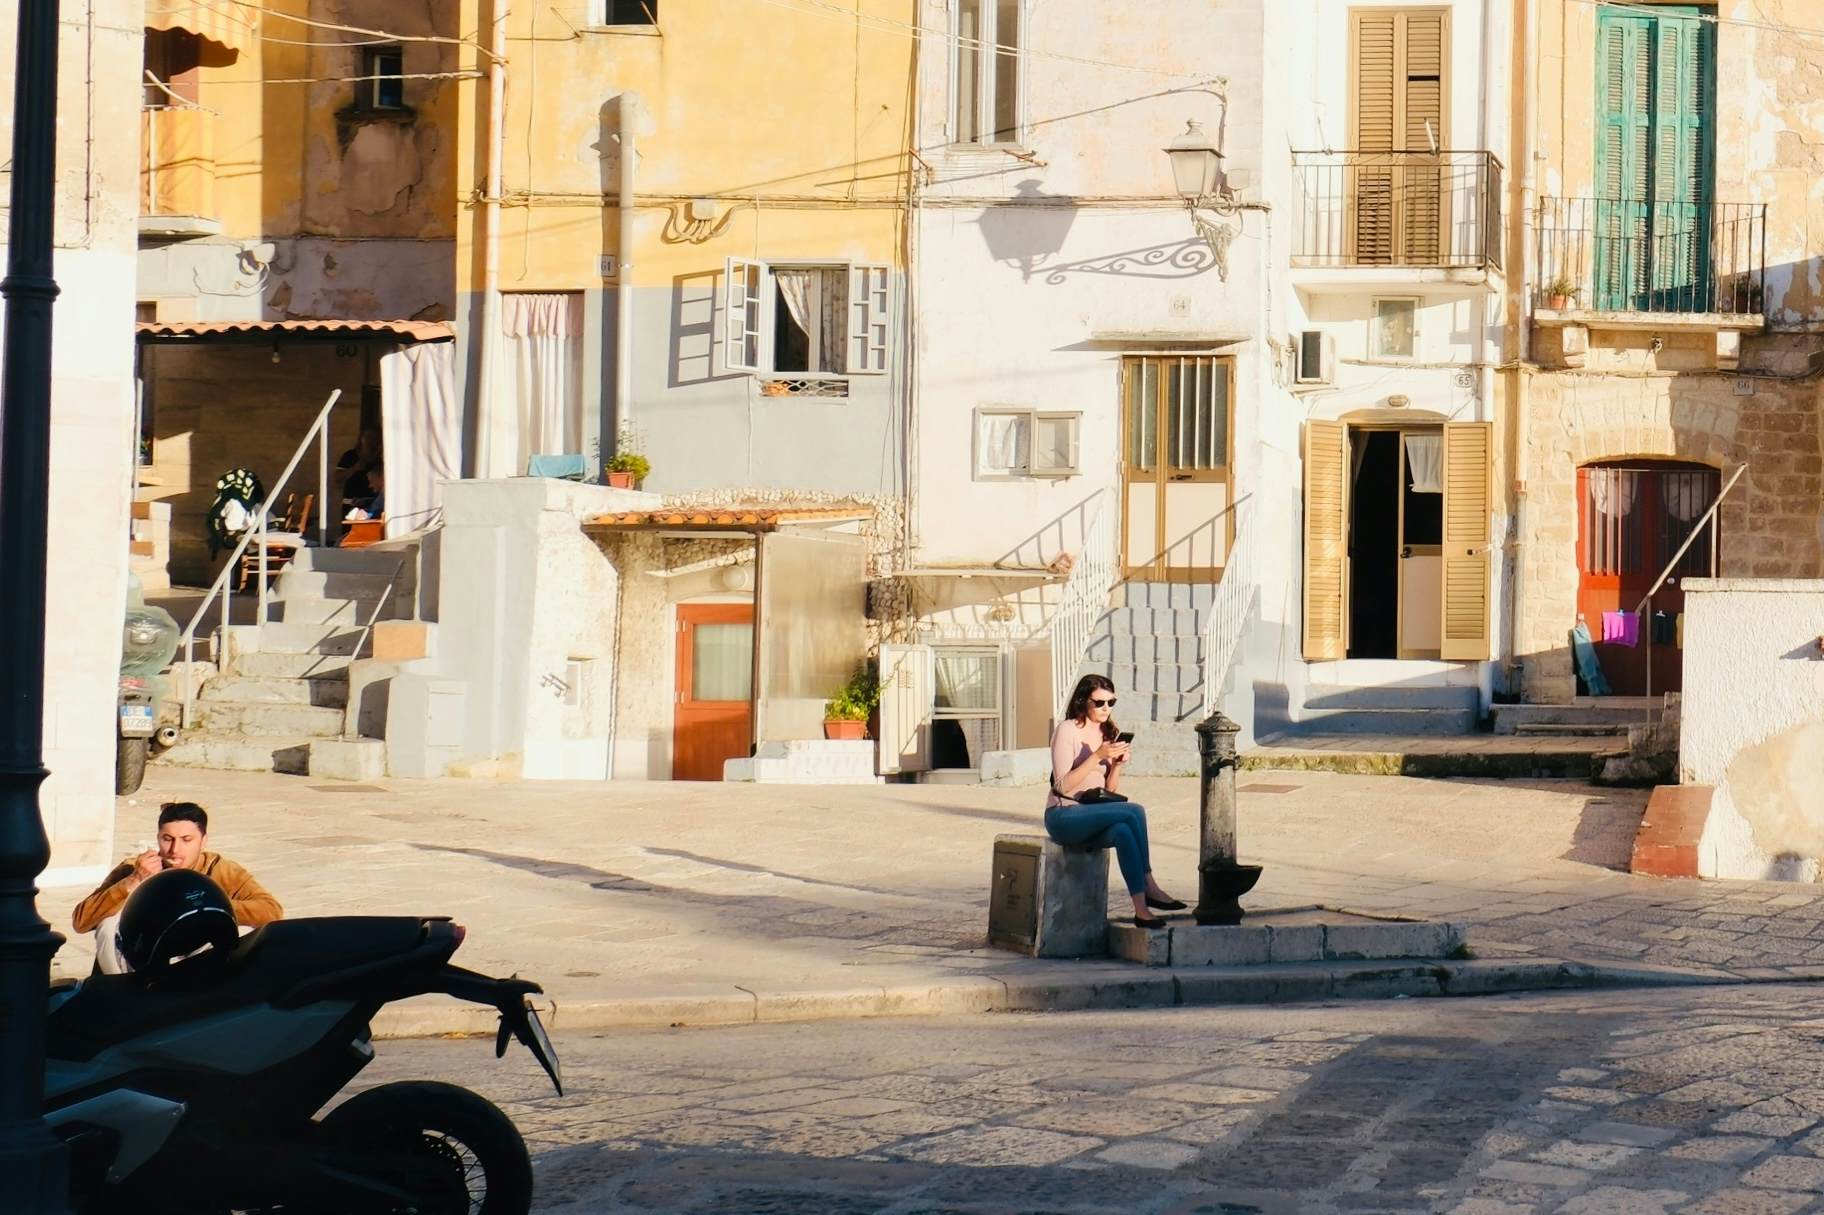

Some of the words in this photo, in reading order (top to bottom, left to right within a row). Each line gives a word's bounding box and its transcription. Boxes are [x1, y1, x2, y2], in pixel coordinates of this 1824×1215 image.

[601, 261, 611, 272] 61
[337, 344, 357, 357] 60
[1458, 376, 1470, 385] 65
